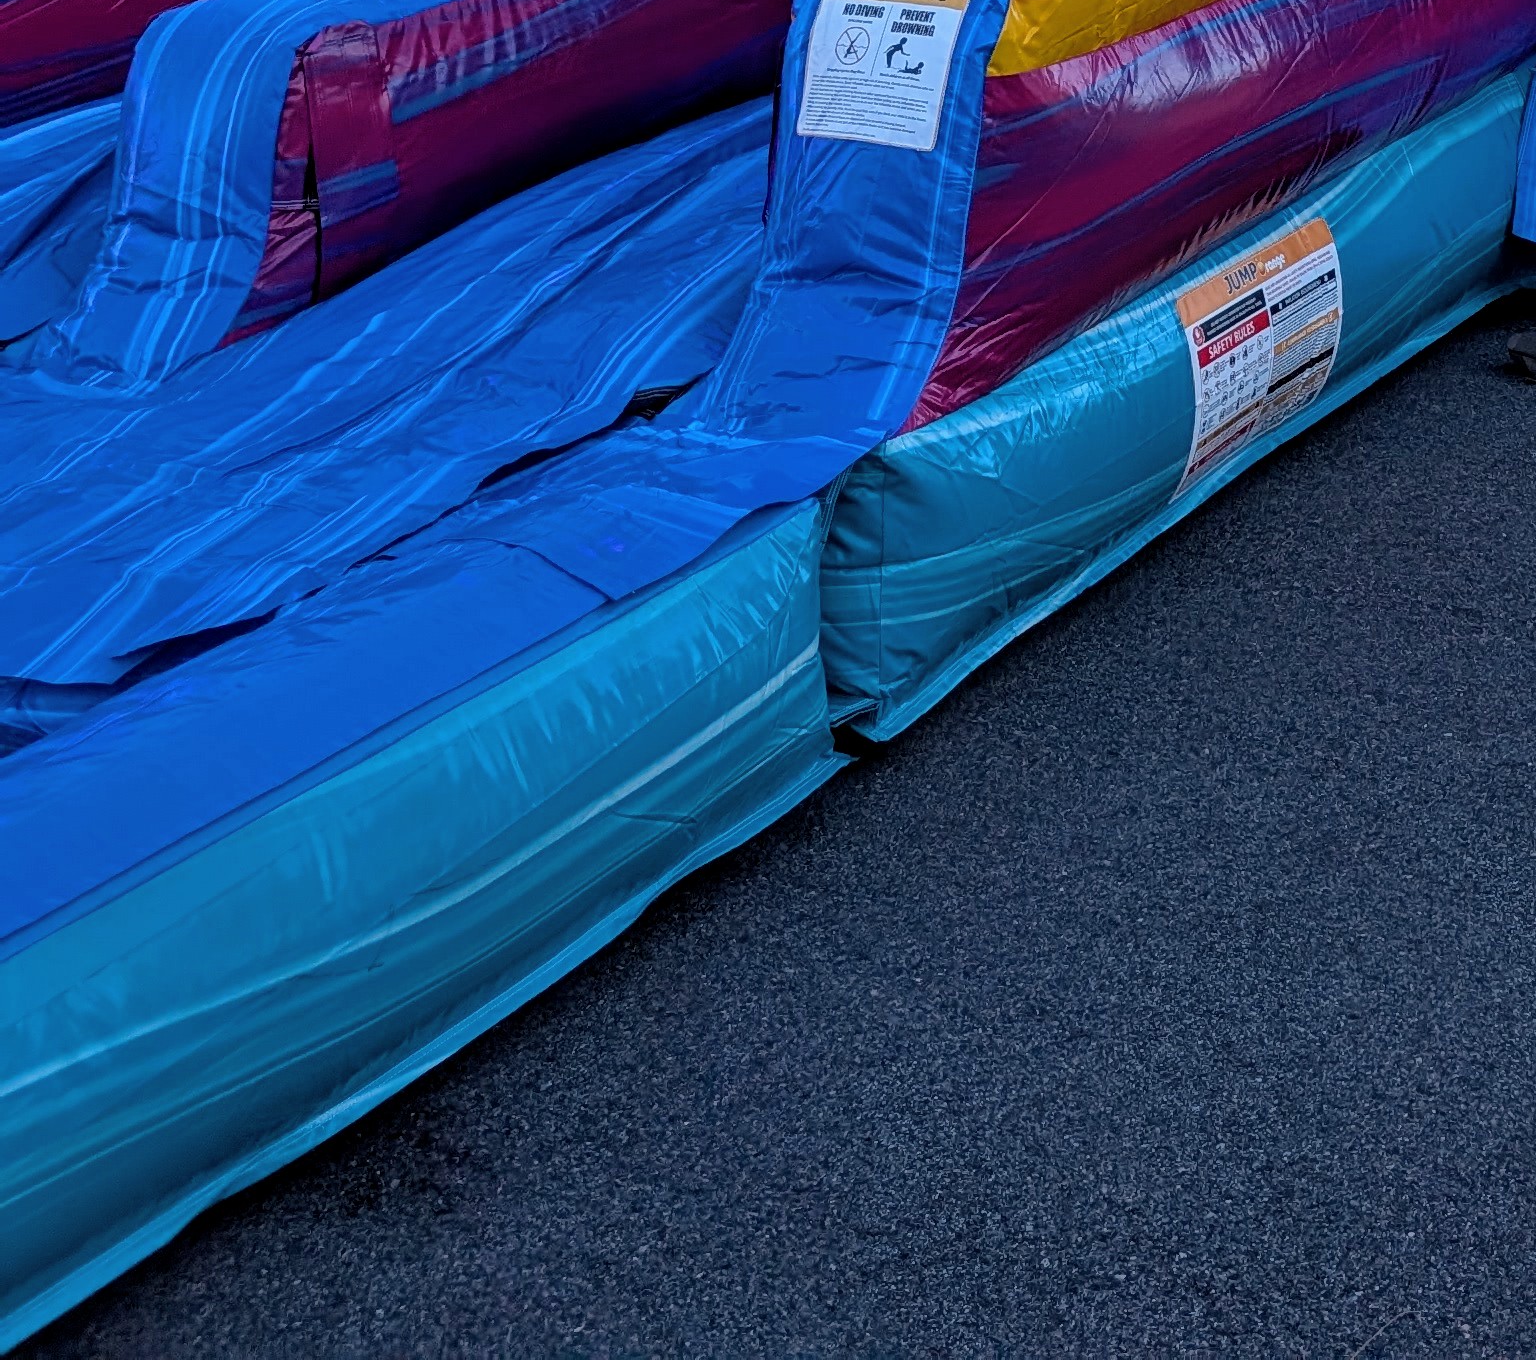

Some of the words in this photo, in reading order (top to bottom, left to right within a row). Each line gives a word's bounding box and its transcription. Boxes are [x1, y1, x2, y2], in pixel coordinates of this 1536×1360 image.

[842, 3, 856, 16] NO
[855, 4, 886, 19] DIVING
[900, 9, 936, 23] PREVENT
[891, 21, 935, 36] DROWNING
[1223, 261, 1258, 296] JUMP
[1208, 333, 1233, 359] SAFETY
[1233, 320, 1256, 344] RULES
